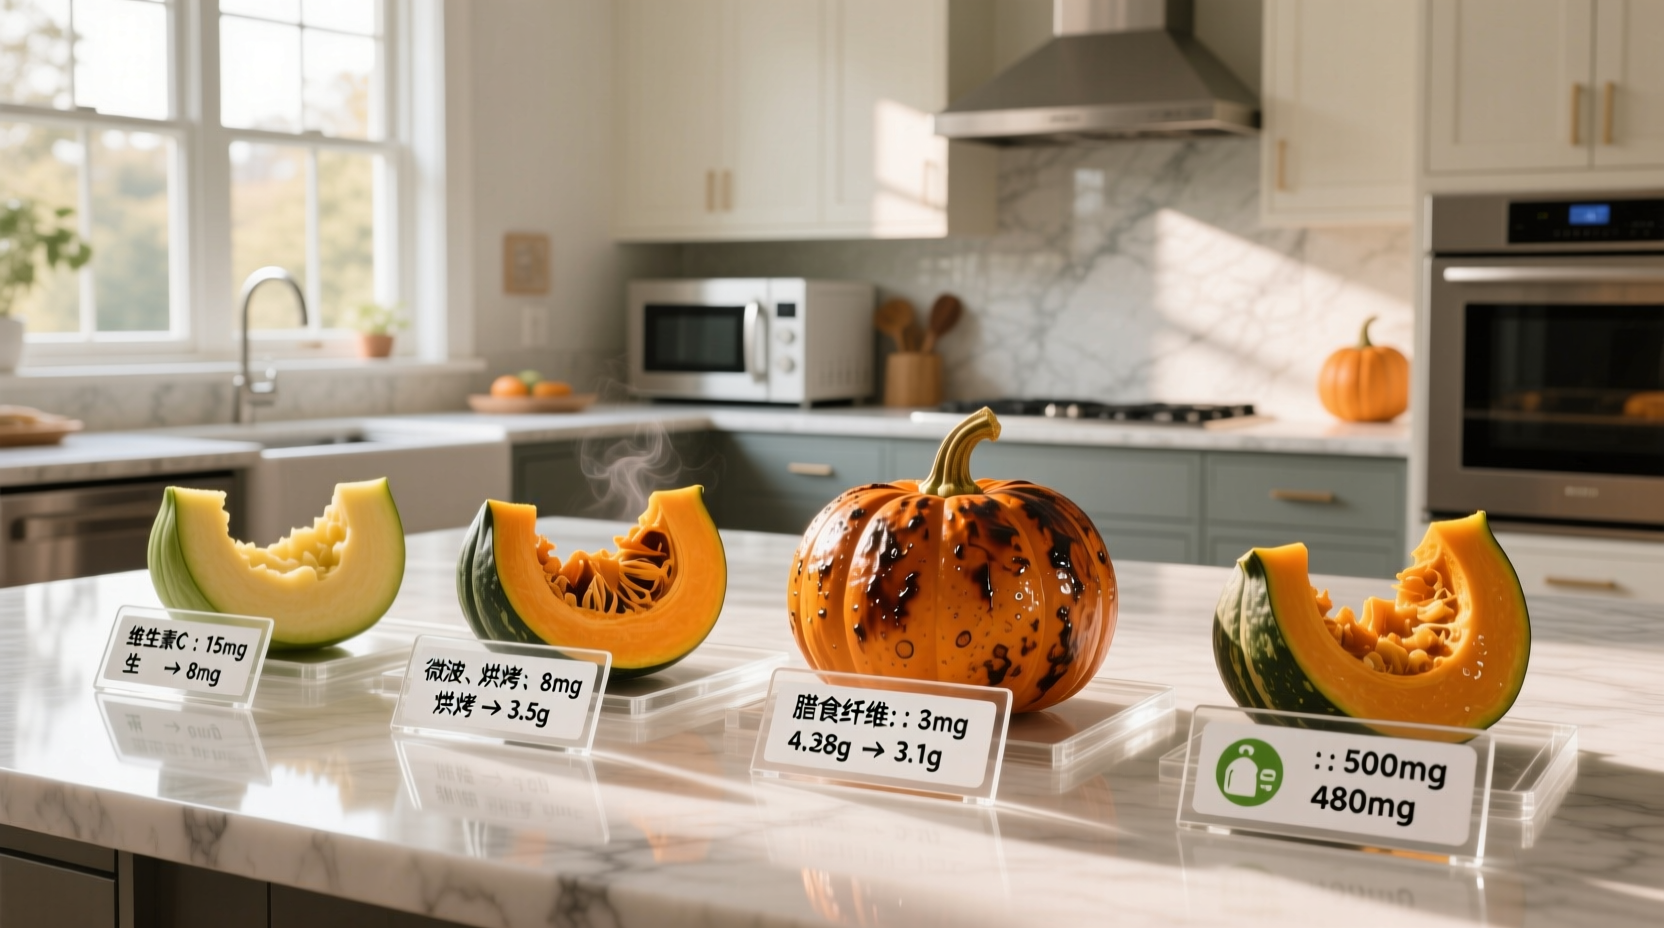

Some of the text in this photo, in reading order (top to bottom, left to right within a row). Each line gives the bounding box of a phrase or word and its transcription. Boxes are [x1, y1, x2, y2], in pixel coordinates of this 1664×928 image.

[122, 652, 222, 687] 生 8mg
[432, 690, 551, 728] 烘烤 3.5g
[893, 740, 943, 773] 3.1g
[1310, 785, 1416, 827] 480mg
